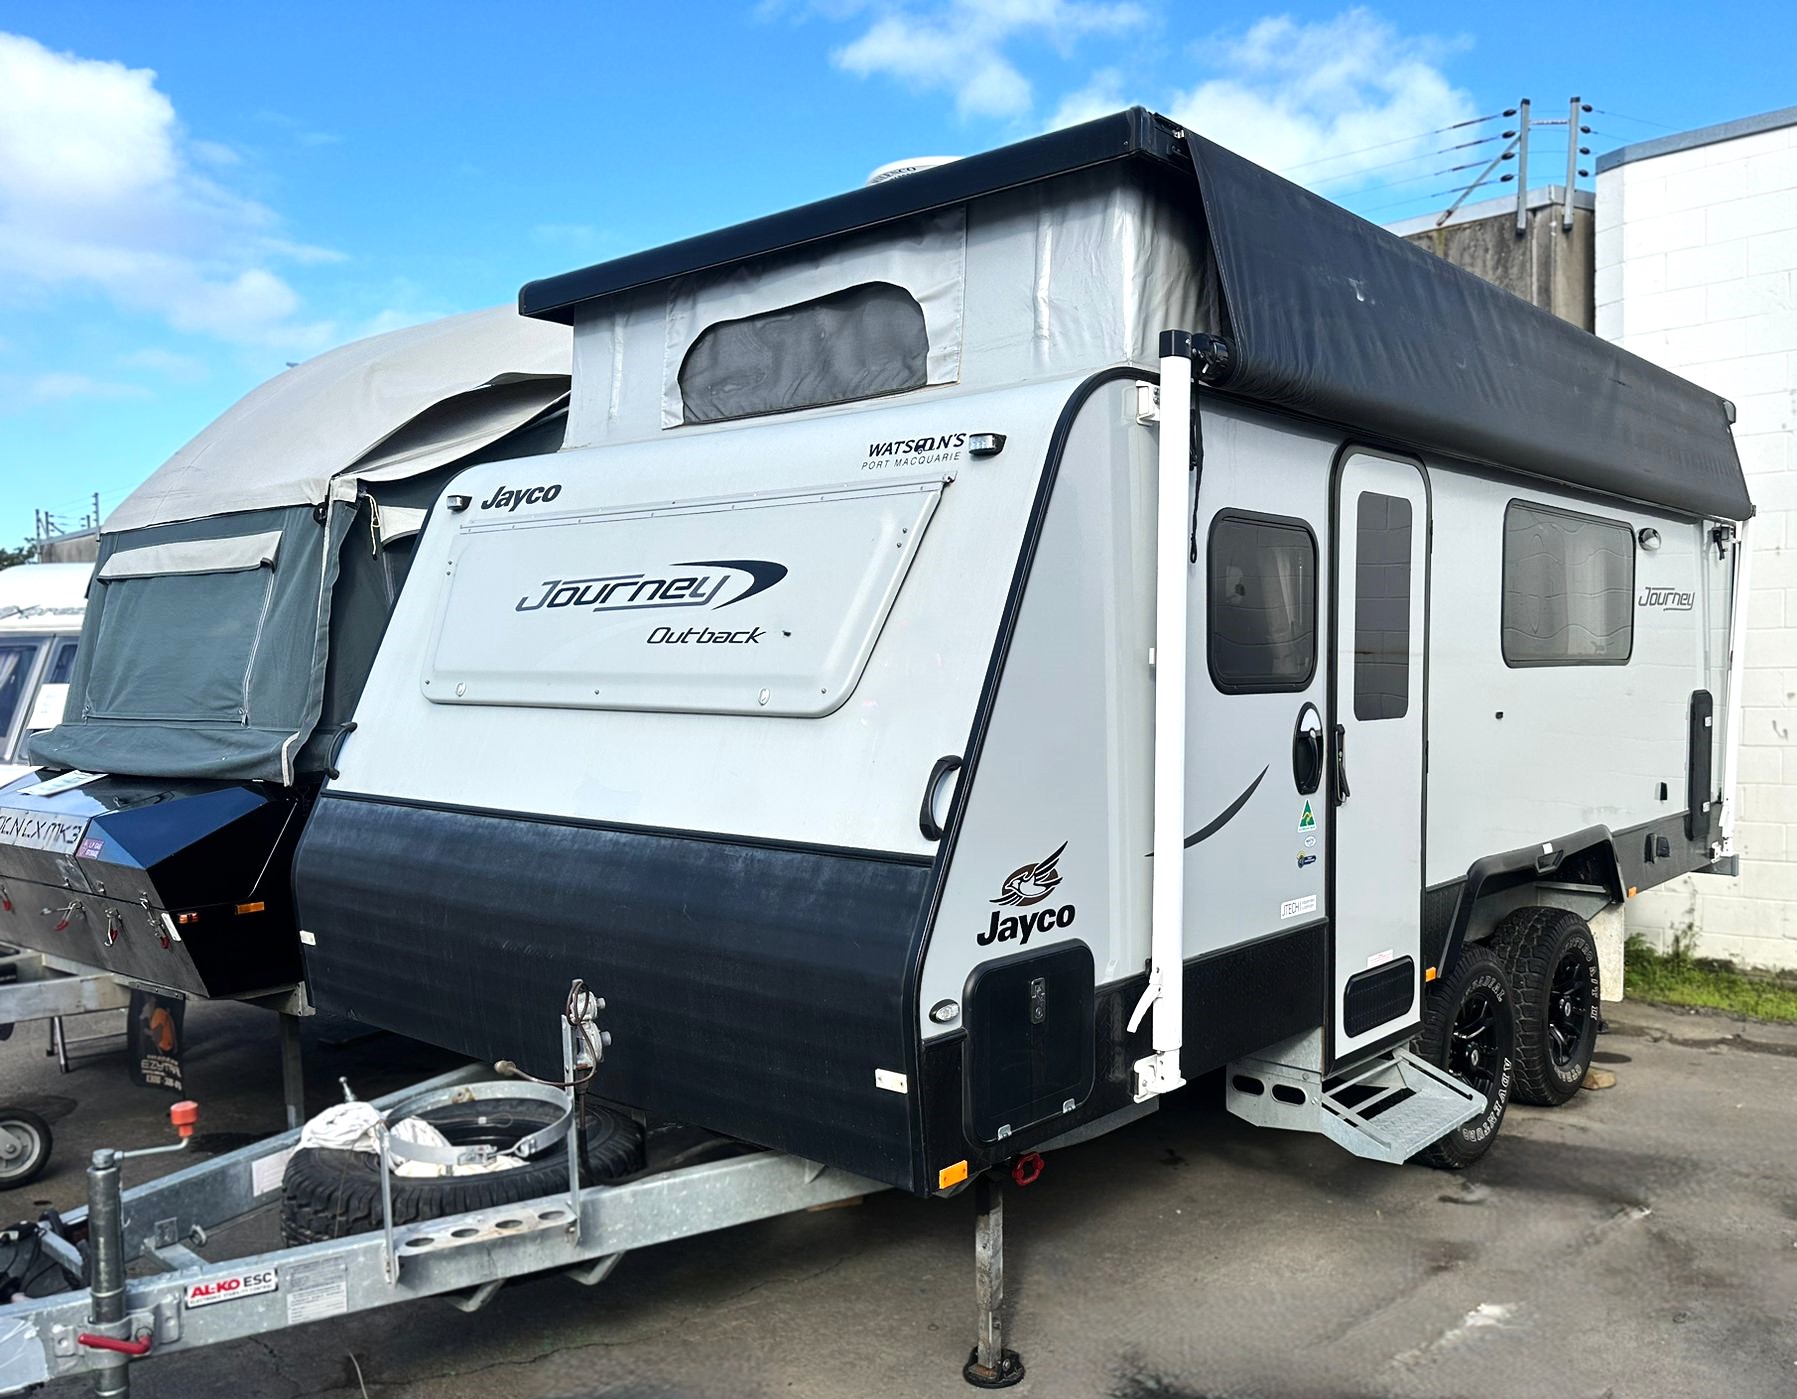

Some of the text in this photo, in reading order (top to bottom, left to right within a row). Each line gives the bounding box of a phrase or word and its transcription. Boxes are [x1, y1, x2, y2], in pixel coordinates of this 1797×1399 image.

[861, 452, 961, 470] PORT MACQUARIE
[480, 484, 562, 512] Jayco
[515, 574, 731, 612] Journey
[1638, 587, 1695, 611] Journey
[647, 626, 766, 644] Outback
[976, 904, 1076, 947] Jayco
[190, 1278, 241, 1298] AL-KO
[243, 1272, 272, 1288] ESC
